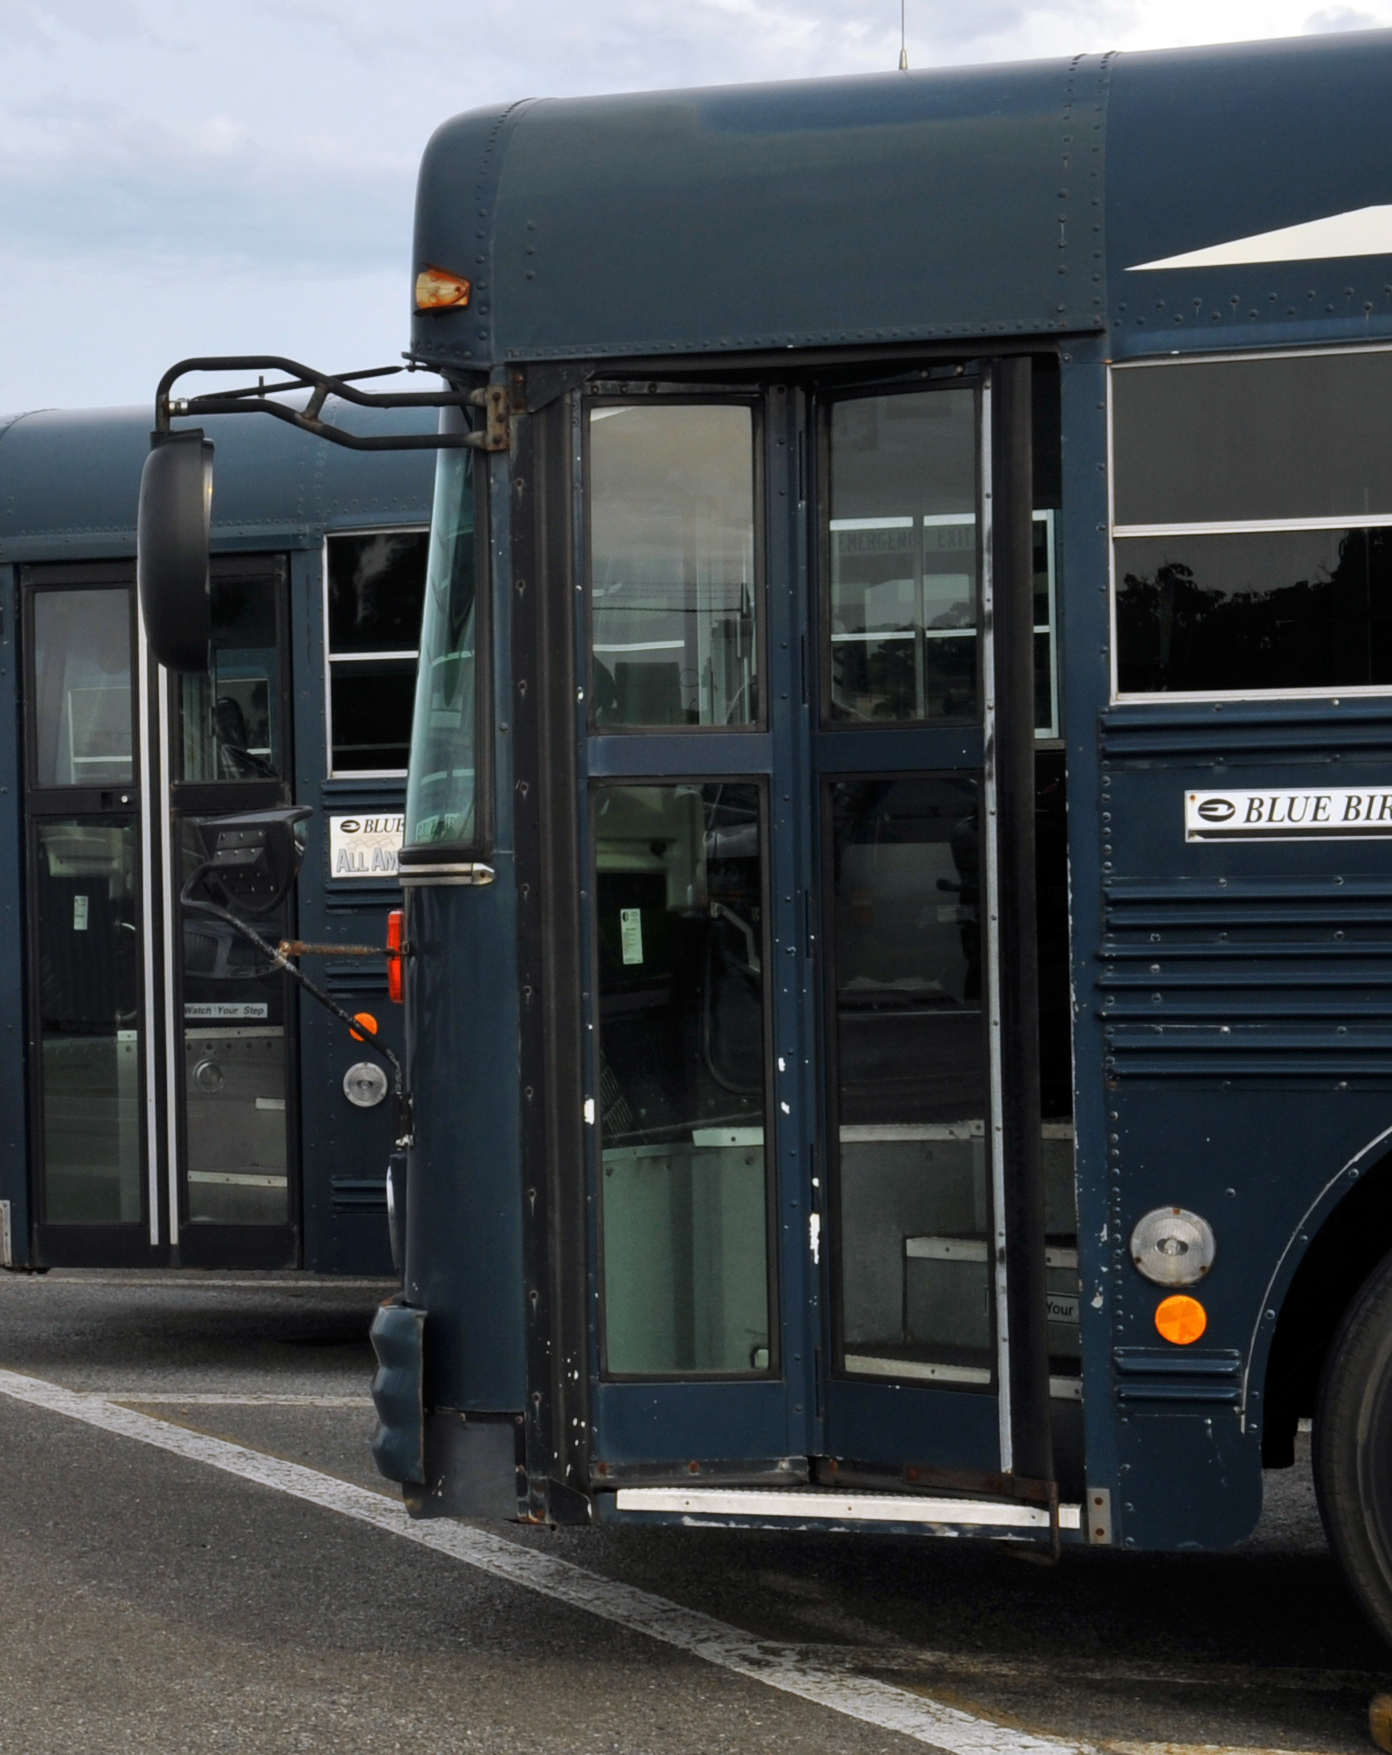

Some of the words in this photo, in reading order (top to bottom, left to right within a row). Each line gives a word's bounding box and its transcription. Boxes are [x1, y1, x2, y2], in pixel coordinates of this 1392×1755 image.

[838, 530, 927, 552] EMERGENC
[938, 527, 971, 548] EXIT
[1243, 796, 1333, 823] BLUE
[336, 848, 369, 873] ALL
[217, 1006, 239, 1015] Your
[243, 1006, 264, 1016] Step
[1046, 1302, 1074, 1316] Your
